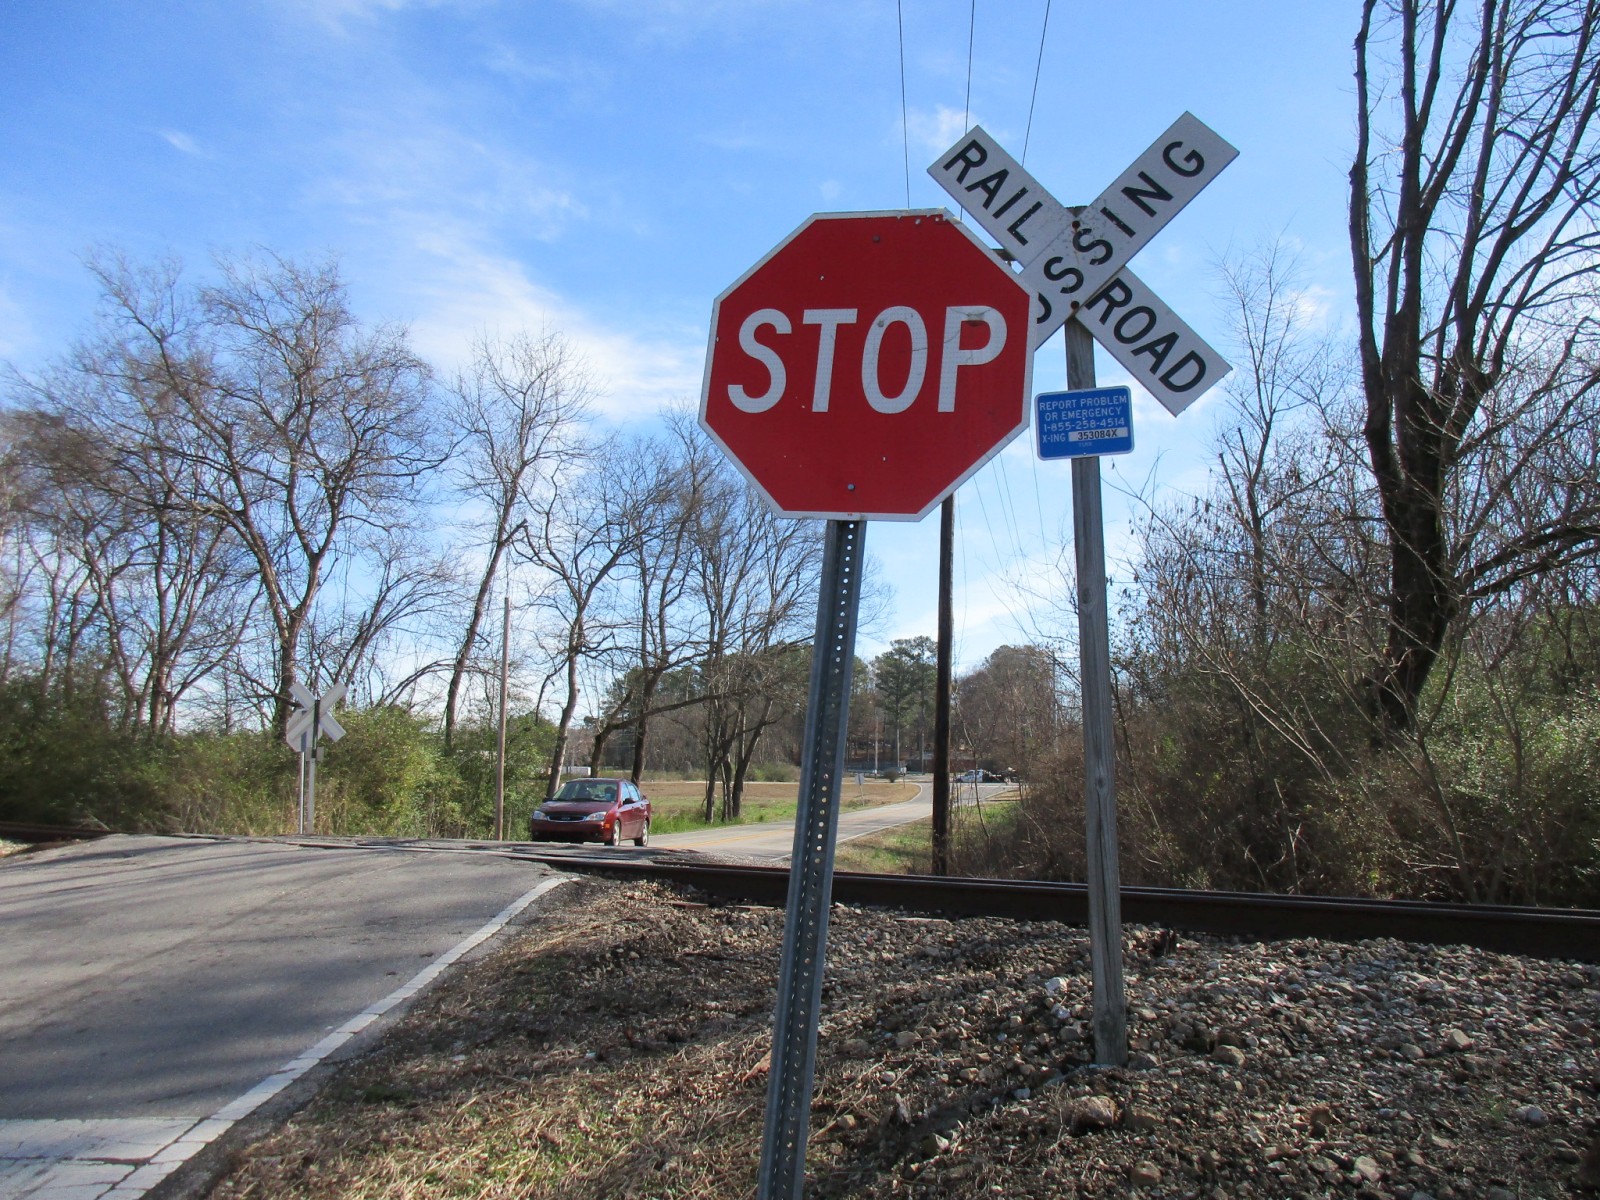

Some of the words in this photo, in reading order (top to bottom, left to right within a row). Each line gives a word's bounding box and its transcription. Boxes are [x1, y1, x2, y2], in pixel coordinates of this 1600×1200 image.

[943, 139, 1043, 246] RAIL
[1084, 277, 1207, 393] ROAD
[727, 305, 1008, 414] STOP
[1039, 400, 1077, 411] REPORT
[1080, 395, 1127, 407] PROBLEM
[1045, 412, 1058, 421] OR
[1061, 406, 1122, 420] EMERGENCY
[1044, 417, 1125, 432] 1-855-258-4514
[1042, 433, 1066, 443] X-ING
[1077, 428, 1118, 441] 353084X
